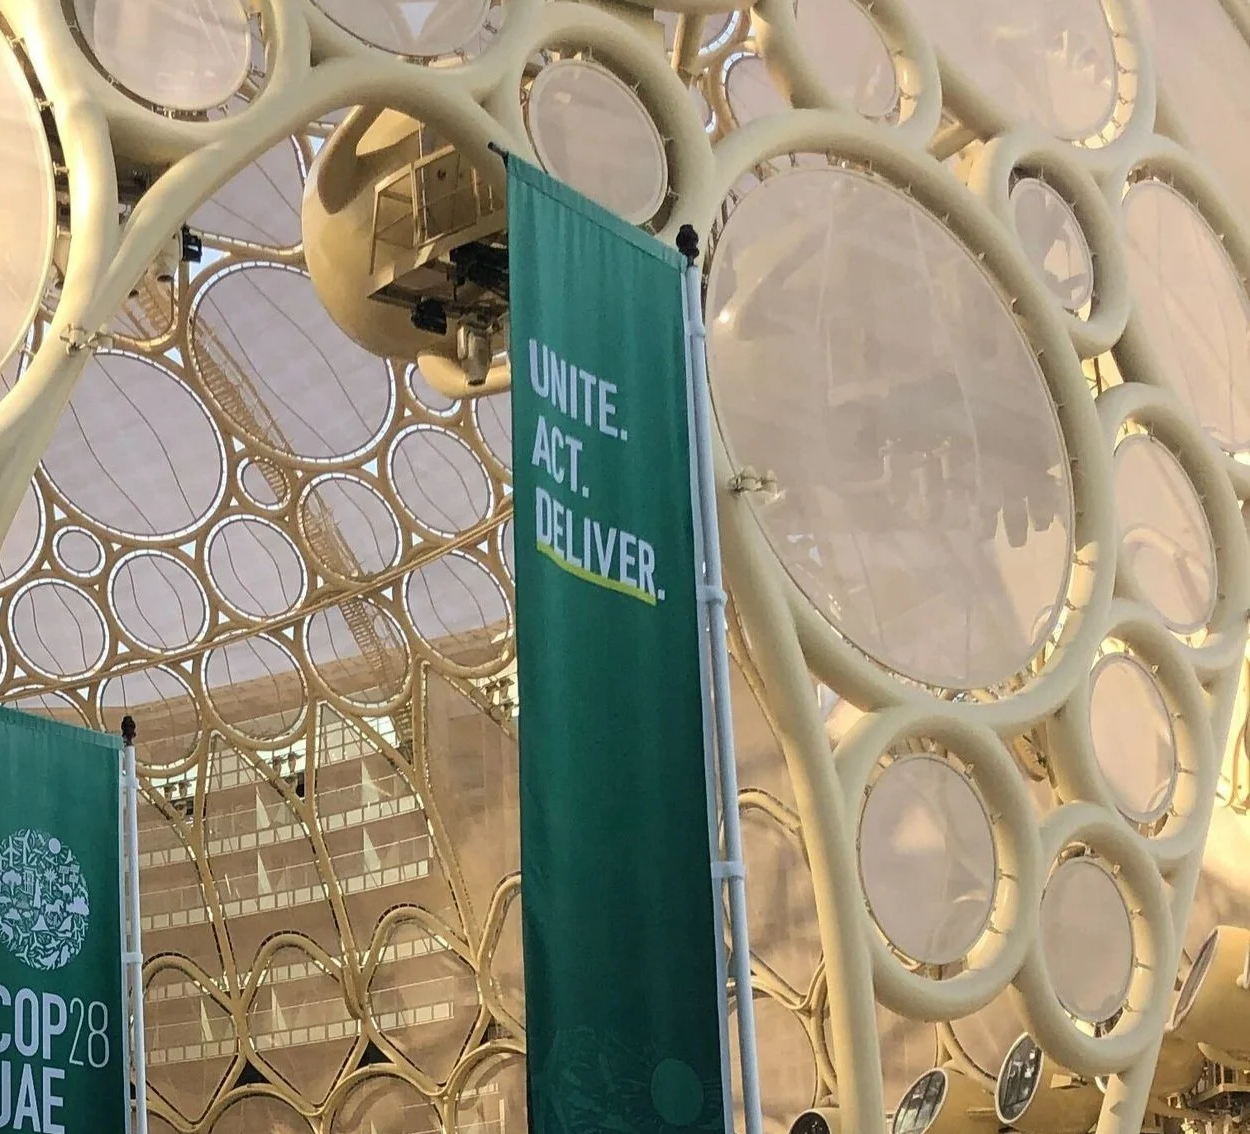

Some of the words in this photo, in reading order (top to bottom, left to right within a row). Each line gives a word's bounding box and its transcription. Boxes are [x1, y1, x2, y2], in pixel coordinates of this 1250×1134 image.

[529, 338, 628, 441] UNITE.
[531, 415, 589, 498] ACT.
[536, 487, 666, 601] DELIVER.
